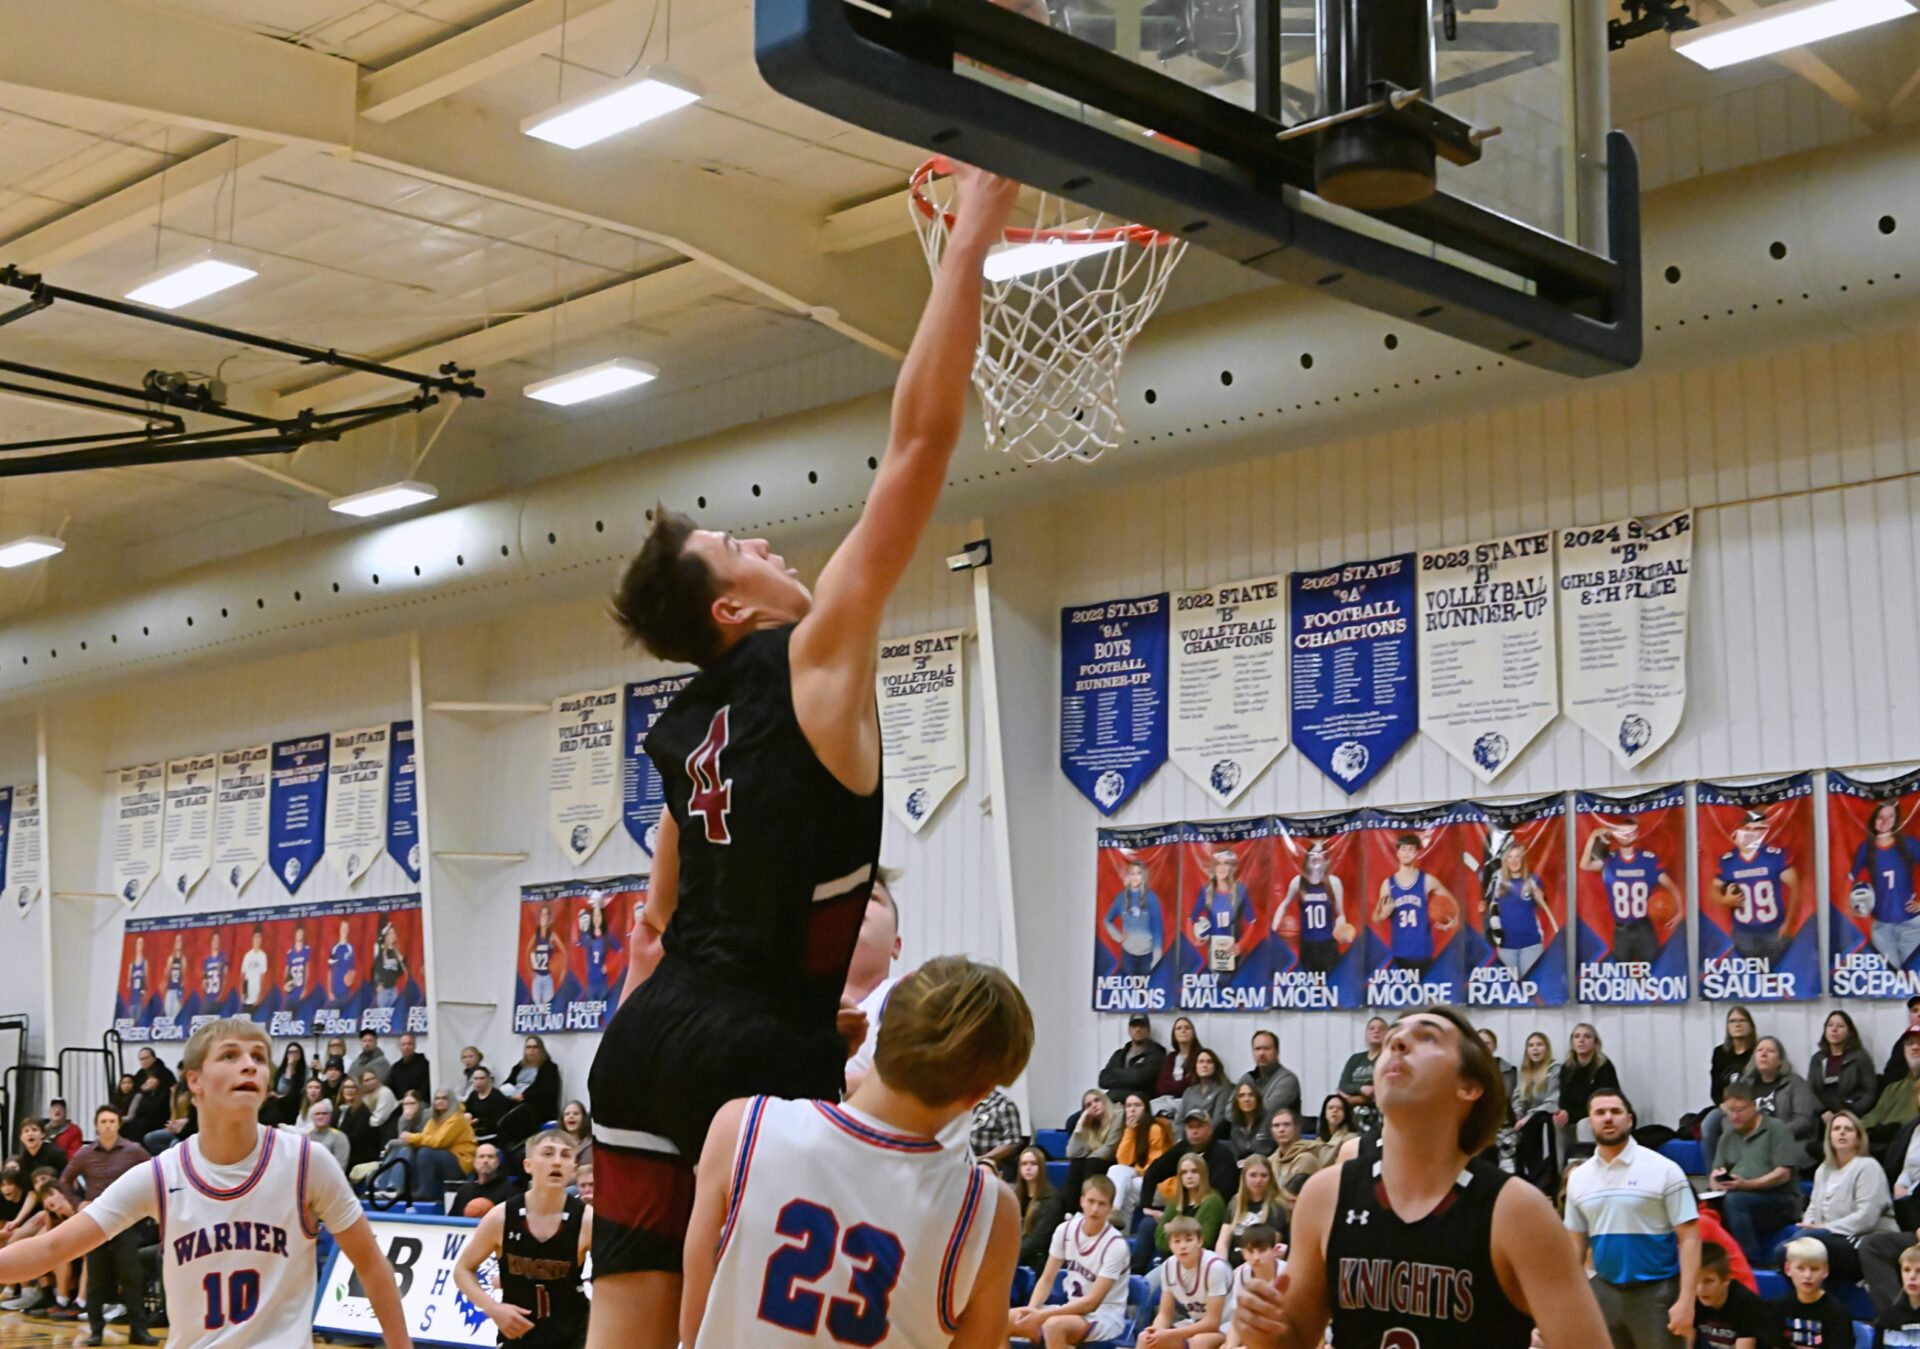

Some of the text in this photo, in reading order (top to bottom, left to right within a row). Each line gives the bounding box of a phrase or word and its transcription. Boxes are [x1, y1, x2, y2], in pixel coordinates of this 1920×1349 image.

[1564, 526, 1620, 548] 2024
[1422, 533, 1550, 571] 2023 STATE
[1301, 560, 1402, 590] 2023 STATE
[1561, 571, 1604, 590] GIRLS
[1177, 582, 1278, 611] 2022 STATE
[1425, 576, 1547, 610] VOLLEYBALL
[1072, 599, 1159, 623] 2022 STATE
[1304, 600, 1400, 629] FOOTBALL
[1425, 596, 1547, 632] RUNNER-UP
[1180, 618, 1276, 641] VOLLEYBALL
[1294, 618, 1407, 648] CHAMPIONS
[881, 635, 960, 658] 2021 STAT
[1094, 640, 1131, 659] BOYS
[1184, 632, 1273, 655] CHAMPIONS
[1079, 658, 1146, 676] FOOTBALL
[685, 704, 733, 845] 4
[1778, 784, 1812, 801] 2025
[1536, 805, 1566, 819] 2025
[1629, 802, 1646, 813] OF
[1652, 796, 1684, 809] 2025
[1242, 827, 1268, 838] 2025
[1336, 822, 1362, 834] 2025
[1367, 820, 1408, 829] CLASS
[1155, 834, 1179, 845] 2025
[1882, 870, 1895, 890] 7
[1612, 881, 1648, 918] 88
[1305, 904, 1326, 929] 10
[1399, 909, 1417, 928] 34
[1580, 962, 1651, 978] HUNTER
[1704, 957, 1769, 974] KADEN
[1835, 953, 1889, 971] LIBBY
[1097, 975, 1151, 990] MELODY
[1182, 973, 1219, 988] EMILY
[1273, 971, 1326, 986] NORAH
[1368, 968, 1419, 984] JAXON
[1703, 972, 1795, 998] SAUER
[1095, 988, 1165, 1009] LANDIS
[1181, 986, 1267, 1008] MALSAM
[1272, 986, 1338, 1008] MOEN
[1367, 982, 1452, 1005] MOORE
[1468, 981, 1538, 1004] RAAP
[1579, 976, 1687, 1001] ROBINSON
[515, 1013, 564, 1032] HAALAND
[566, 1012, 601, 1029] HOLT
[173, 1222, 289, 1266] WARNER
[757, 1196, 906, 1349] 23
[201, 1269, 261, 1331] 10
[1338, 1257, 1474, 1323] KNIGHTS
